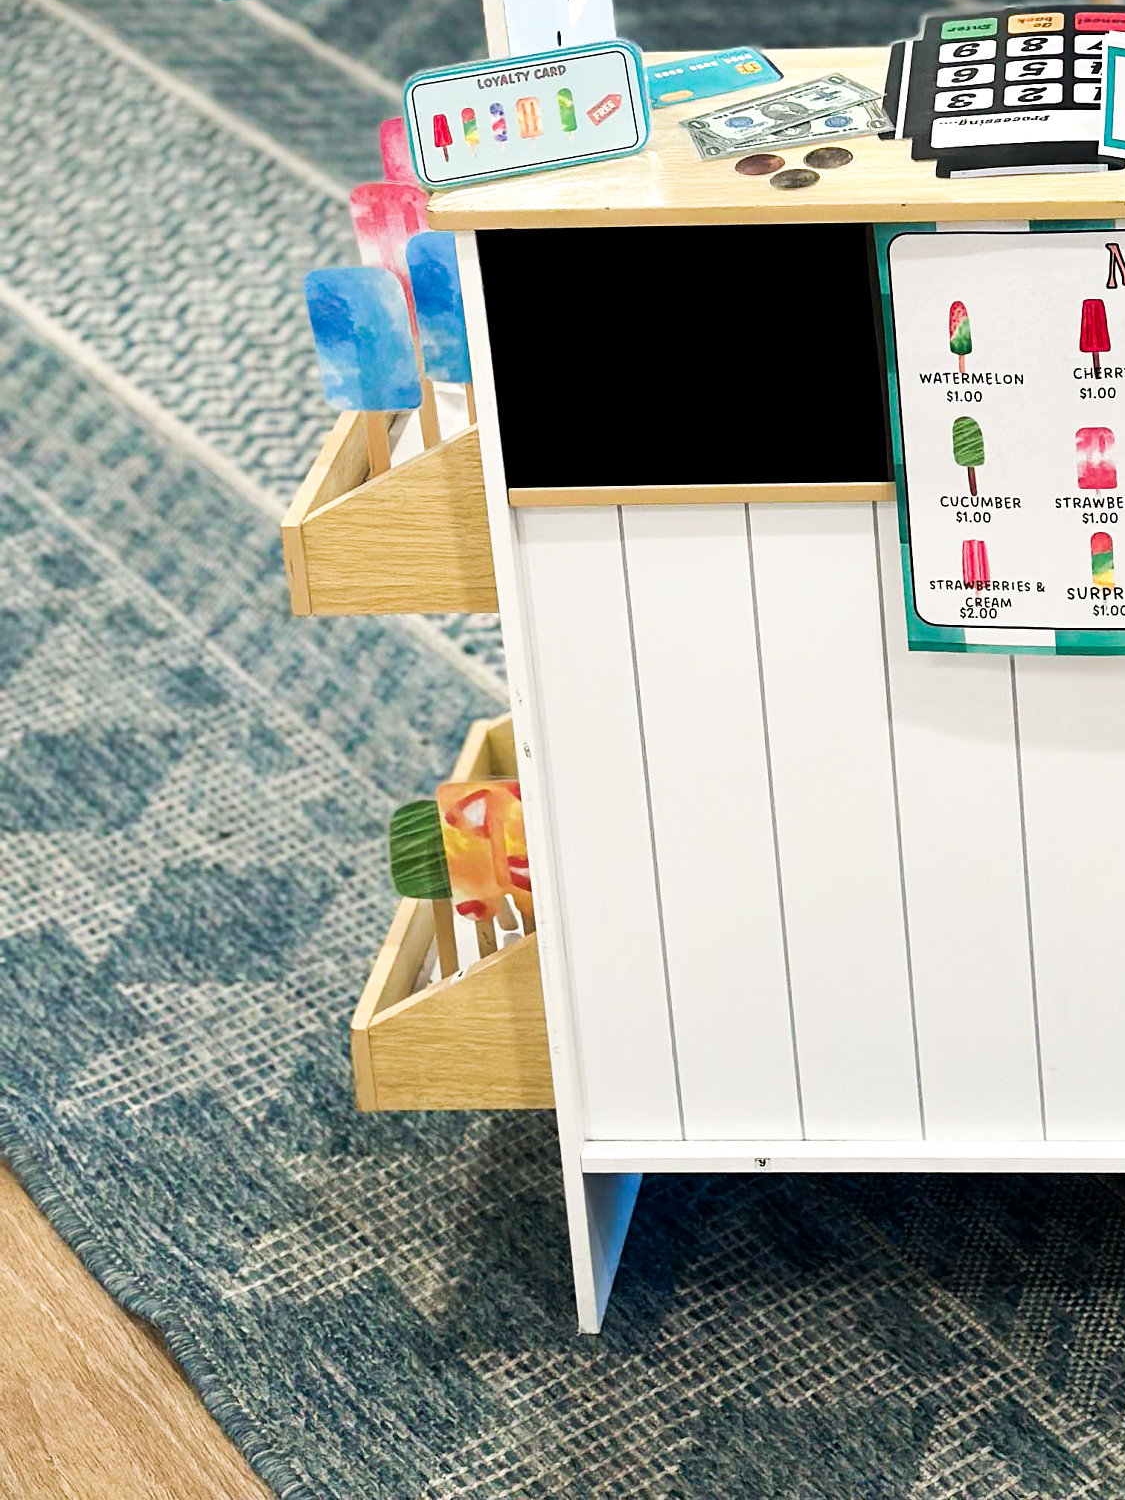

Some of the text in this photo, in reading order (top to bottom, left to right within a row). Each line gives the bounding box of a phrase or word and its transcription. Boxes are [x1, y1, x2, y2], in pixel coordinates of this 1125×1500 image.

[946, 23, 993, 32] Enter
[1020, 37, 1049, 52] 8
[1018, 61, 1048, 77] 5
[477, 65, 567, 90] LOYALTY CARD
[1018, 86, 1047, 102] 2
[947, 93, 977, 109] 3
[592, 99, 617, 121] FREE
[919, 372, 1025, 385] WATERMELON
[946, 390, 983, 403] $1.00
[1079, 387, 1117, 400] $1.00
[940, 496, 1022, 509] CUCUMBER
[955, 511, 992, 524] $1.00
[1081, 512, 1119, 525] $1.00
[929, 580, 1046, 592] STRAWBERRIES &
[965, 596, 1012, 608] CREAM
[959, 607, 998, 619] $2.00
